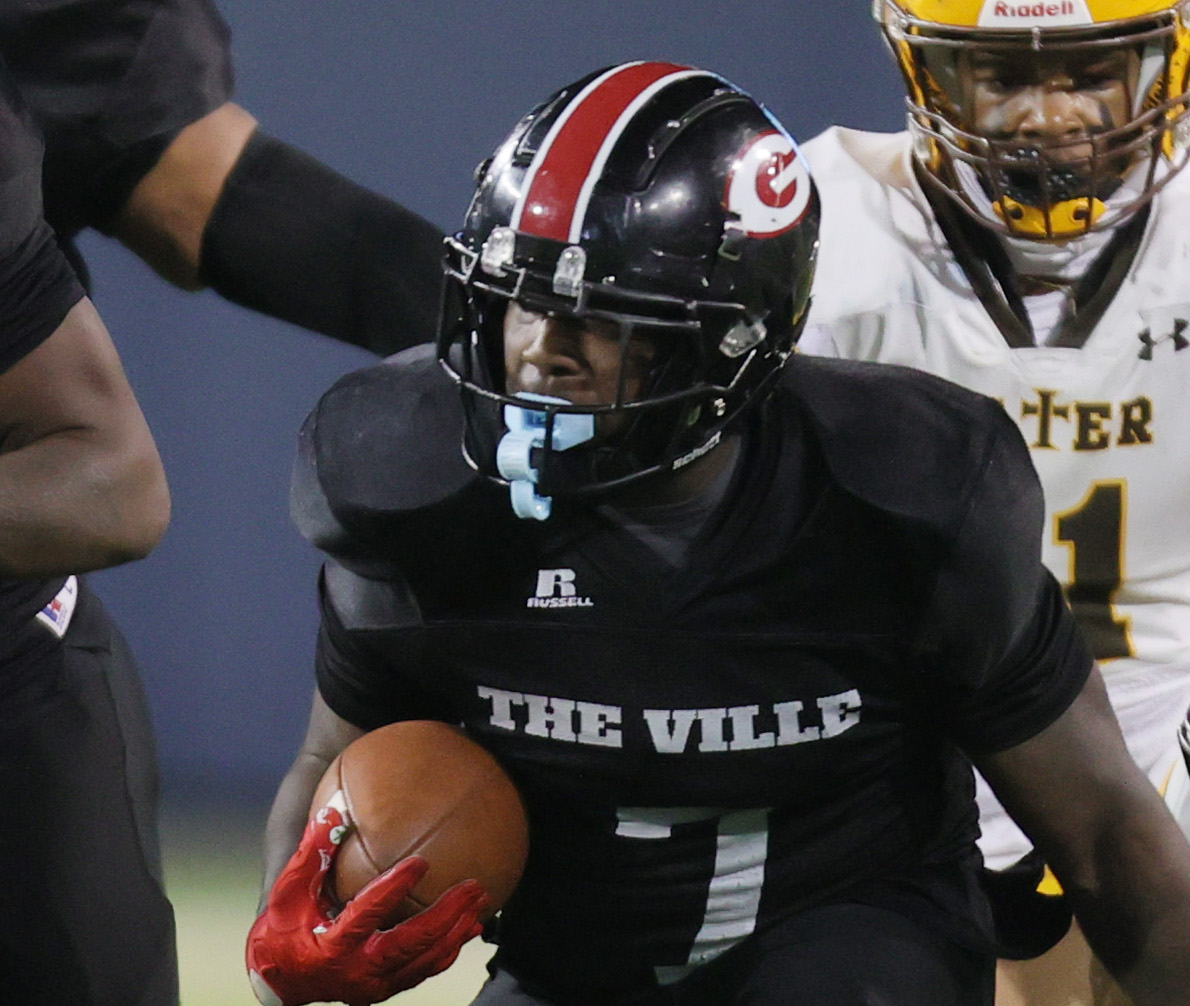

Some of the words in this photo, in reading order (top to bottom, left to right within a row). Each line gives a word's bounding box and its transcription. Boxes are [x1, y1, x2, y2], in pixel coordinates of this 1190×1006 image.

[999, 388, 1154, 452] TER
[527, 597, 594, 608] RUSSELL
[477, 685, 623, 748] THE
[643, 688, 862, 754] VILLE
[615, 807, 773, 986] 7
